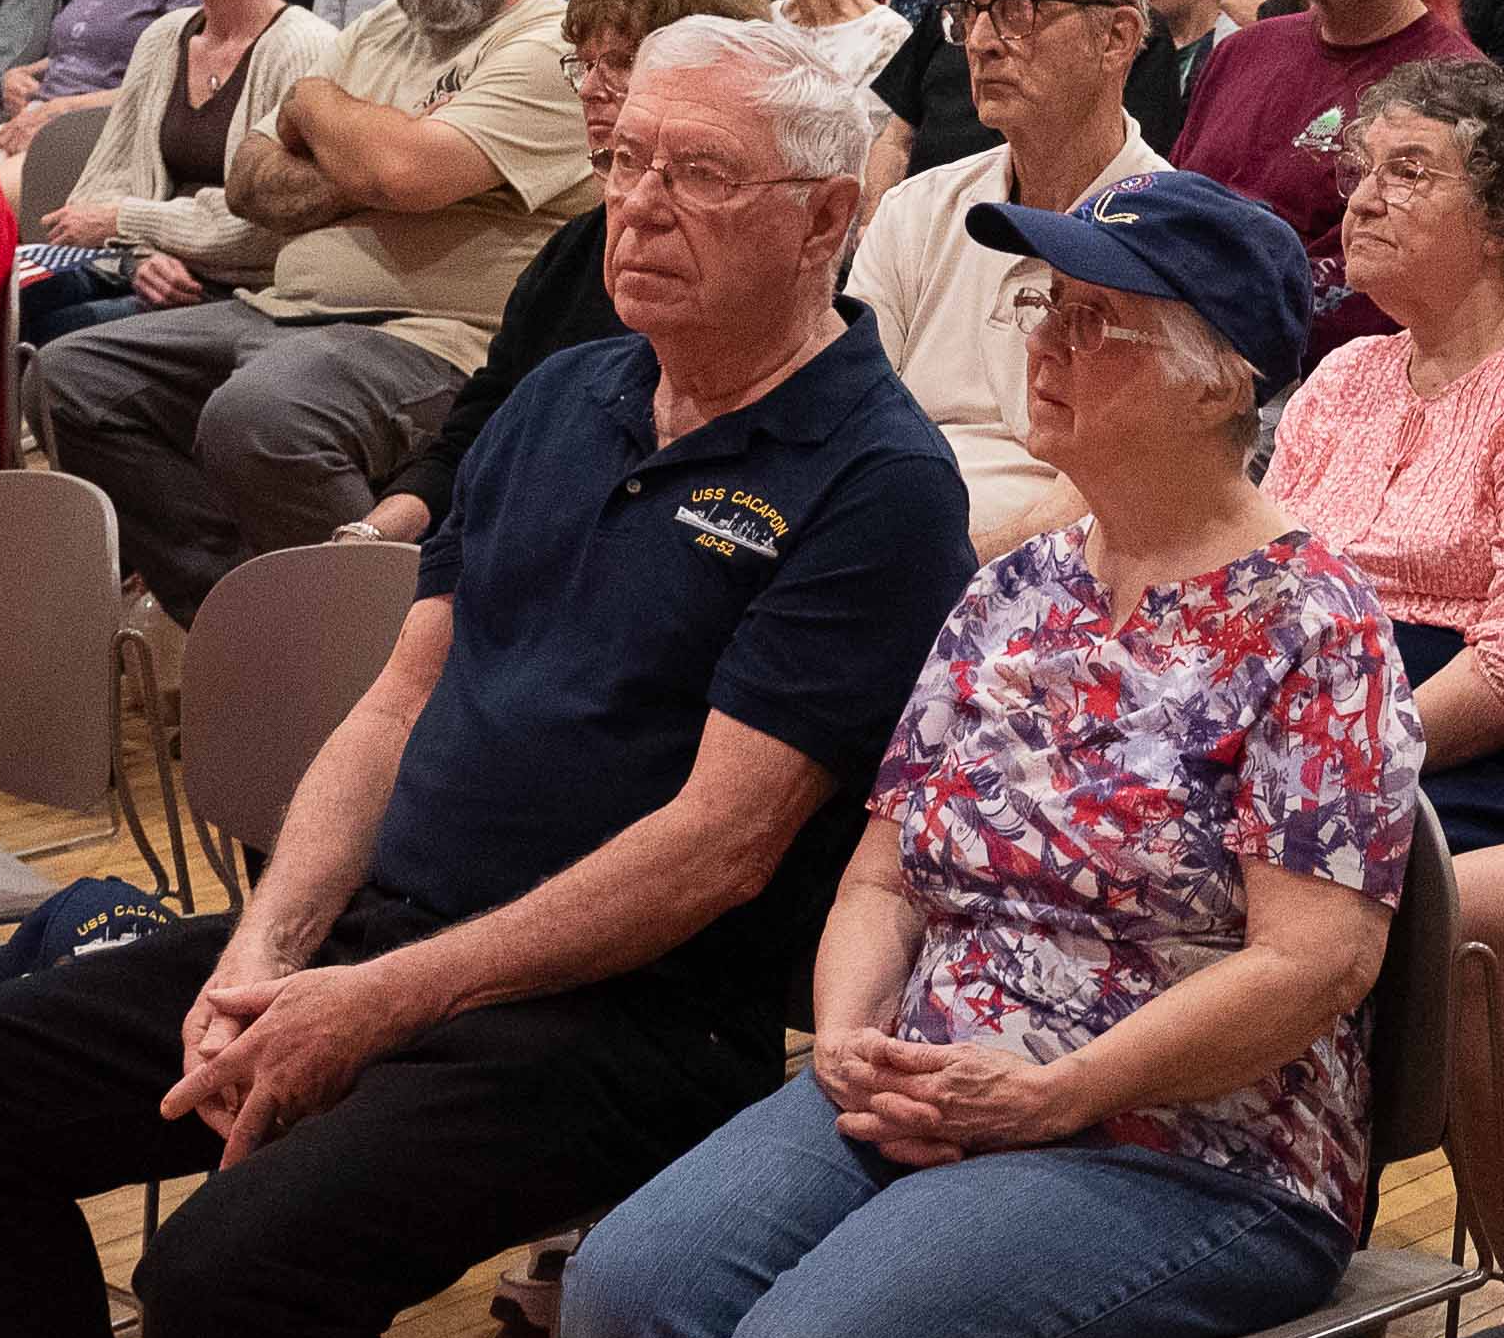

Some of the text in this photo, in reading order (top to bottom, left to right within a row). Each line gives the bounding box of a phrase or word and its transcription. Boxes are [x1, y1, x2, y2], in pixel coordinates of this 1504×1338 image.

[691, 488, 789, 537] USS CACAPON
[695, 533, 736, 557] AO-52
[76, 912, 109, 937] USS
